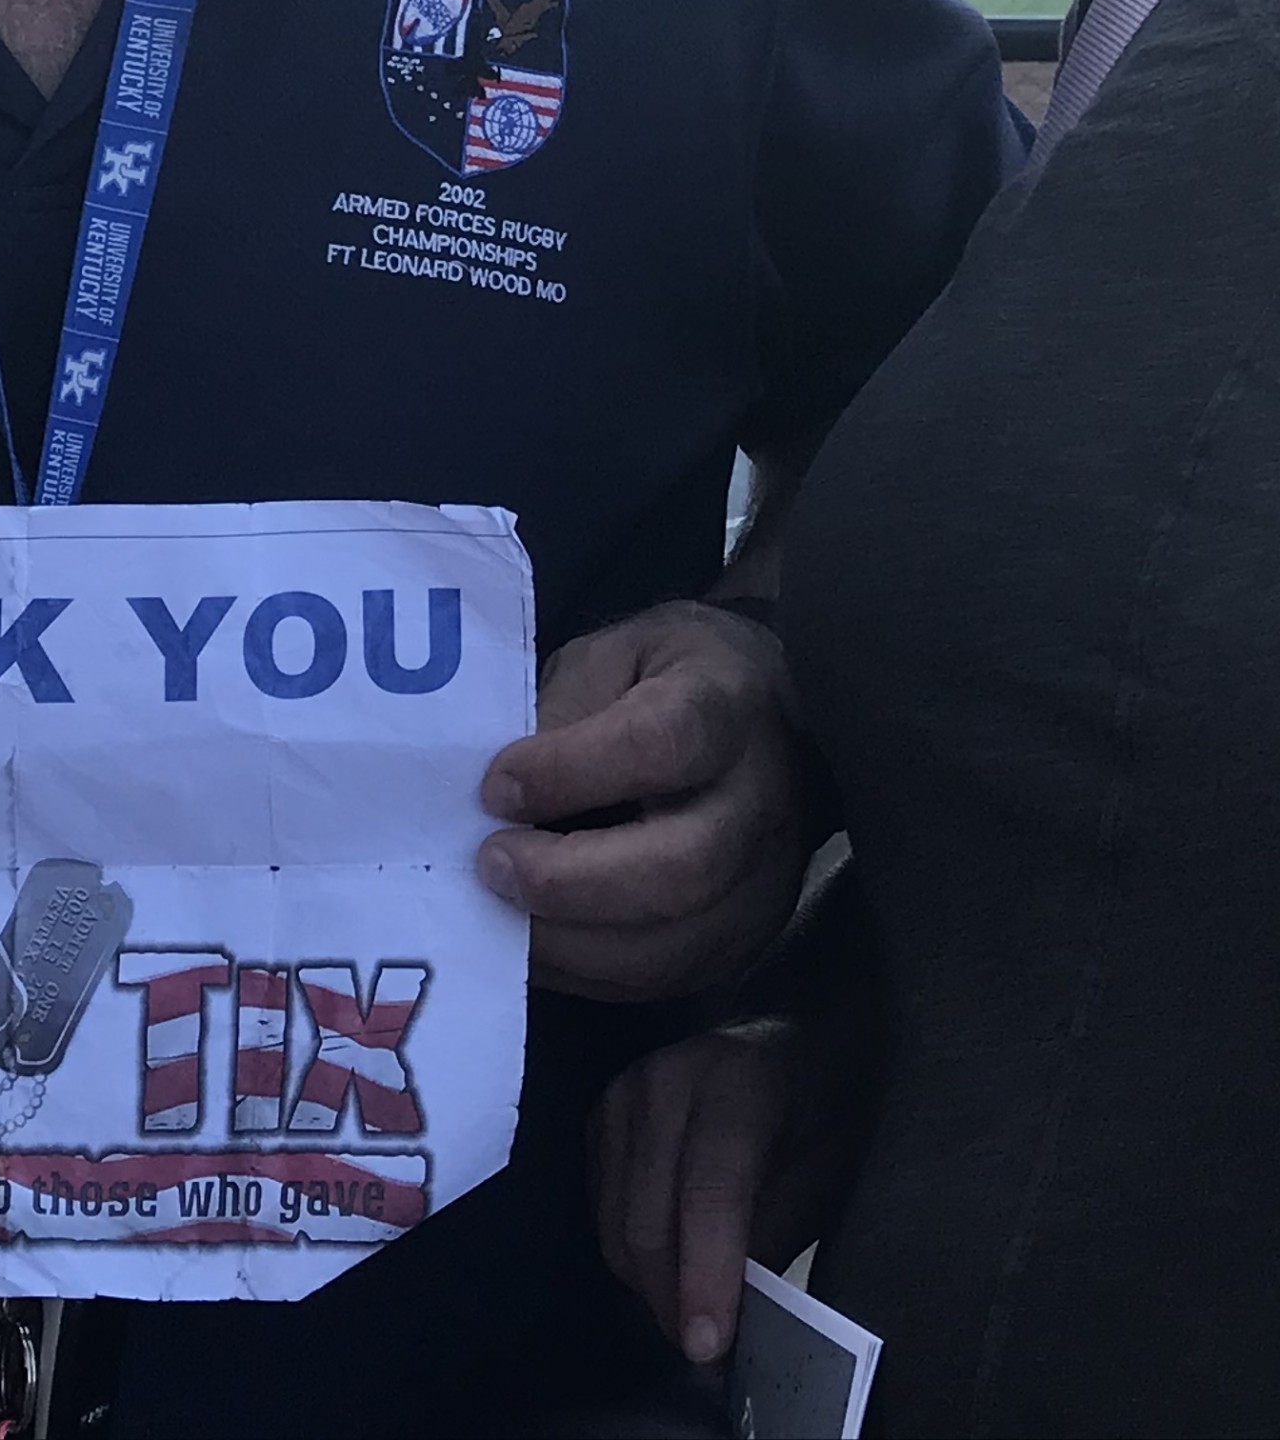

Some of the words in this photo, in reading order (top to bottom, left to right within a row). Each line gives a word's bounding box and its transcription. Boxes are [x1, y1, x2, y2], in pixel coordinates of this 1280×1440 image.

[116, 14, 152, 113] KENTUCKY
[147, 17, 178, 99] UNIVERSITY
[143, 101, 162, 119] OF
[332, 192, 410, 220] ARMED
[415, 204, 496, 237] FORCES
[501, 220, 568, 251] RUGBY
[438, 182, 486, 209] 2002
[76, 217, 108, 320] KENTUCKY
[102, 222, 132, 305] UNIVERSITY
[327, 243, 356, 265] FT
[360, 248, 463, 282] LEONARD
[470, 266, 532, 296] WOOD
[536, 279, 567, 303] MO
[373, 224, 537, 272] CHAMPIONSHIPS
[98, 308, 113, 327] OF
[127, 587, 463, 702] YOU
[56, 908, 99, 974] ADMIT
[31, 981, 60, 1022] ONE
[117, 945, 432, 1140] TIX
[32, 1173, 158, 1217] those
[177, 1173, 262, 1218] who
[280, 1177, 386, 1224] gave
